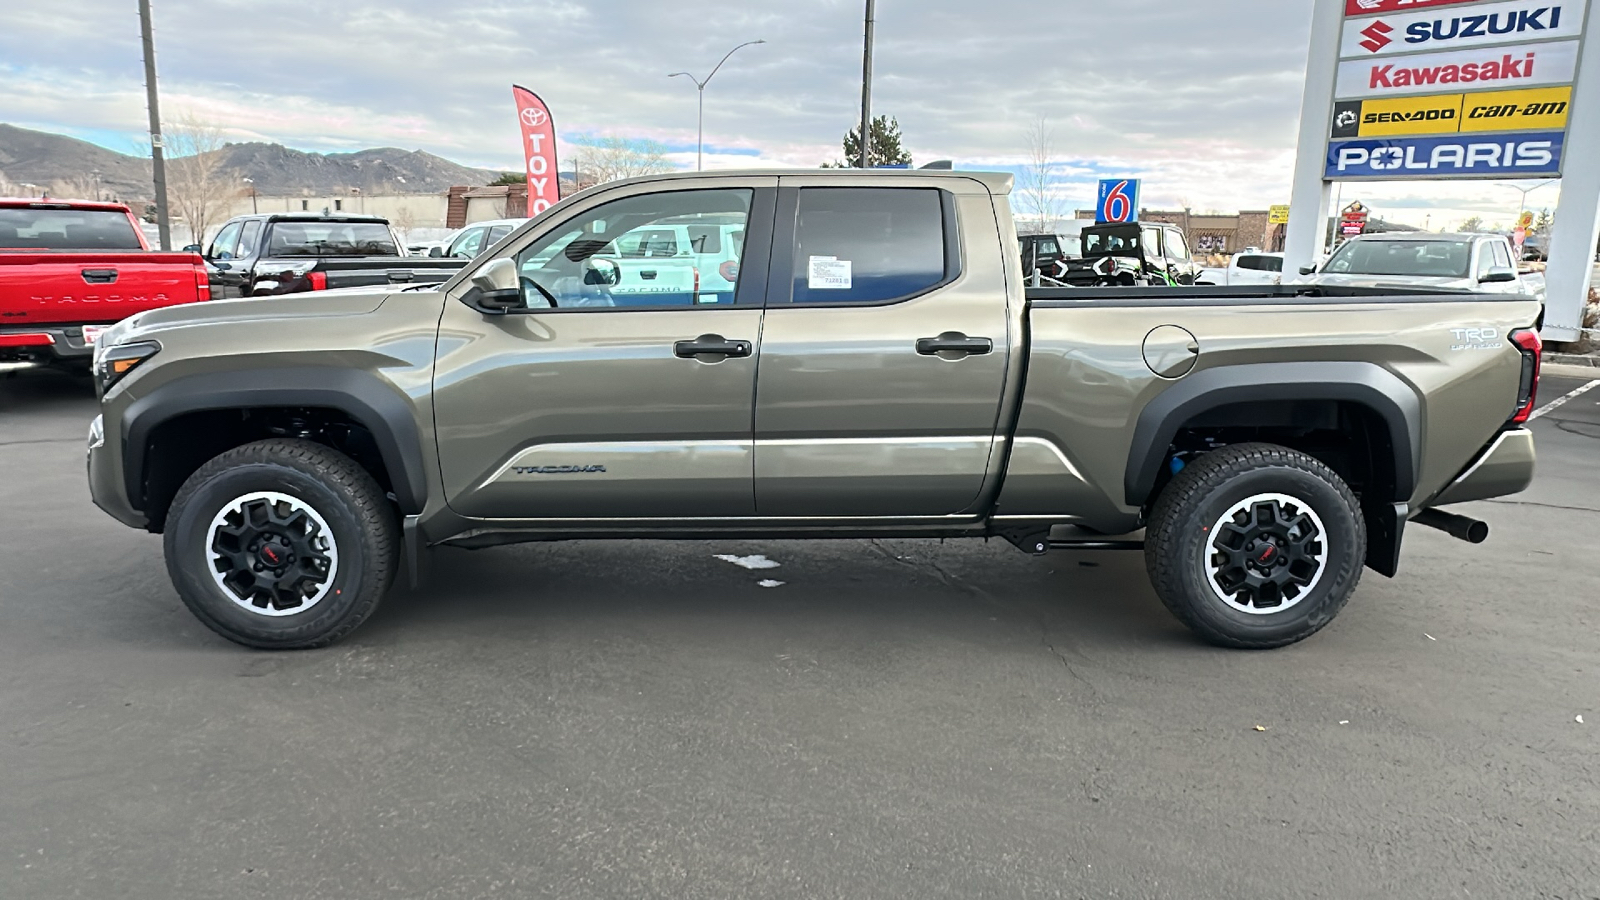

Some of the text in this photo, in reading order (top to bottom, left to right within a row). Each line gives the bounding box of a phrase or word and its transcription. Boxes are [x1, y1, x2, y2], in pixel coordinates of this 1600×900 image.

[1404, 6, 1561, 44] SUZUKI
[1369, 52, 1535, 89] Kawasaki
[1337, 141, 1552, 171] POLARIS
[1104, 181, 1130, 222] 6
[31, 293, 169, 303] TACOMA
[1450, 328, 1498, 342] TRD
[511, 464, 606, 474] TACOMA
